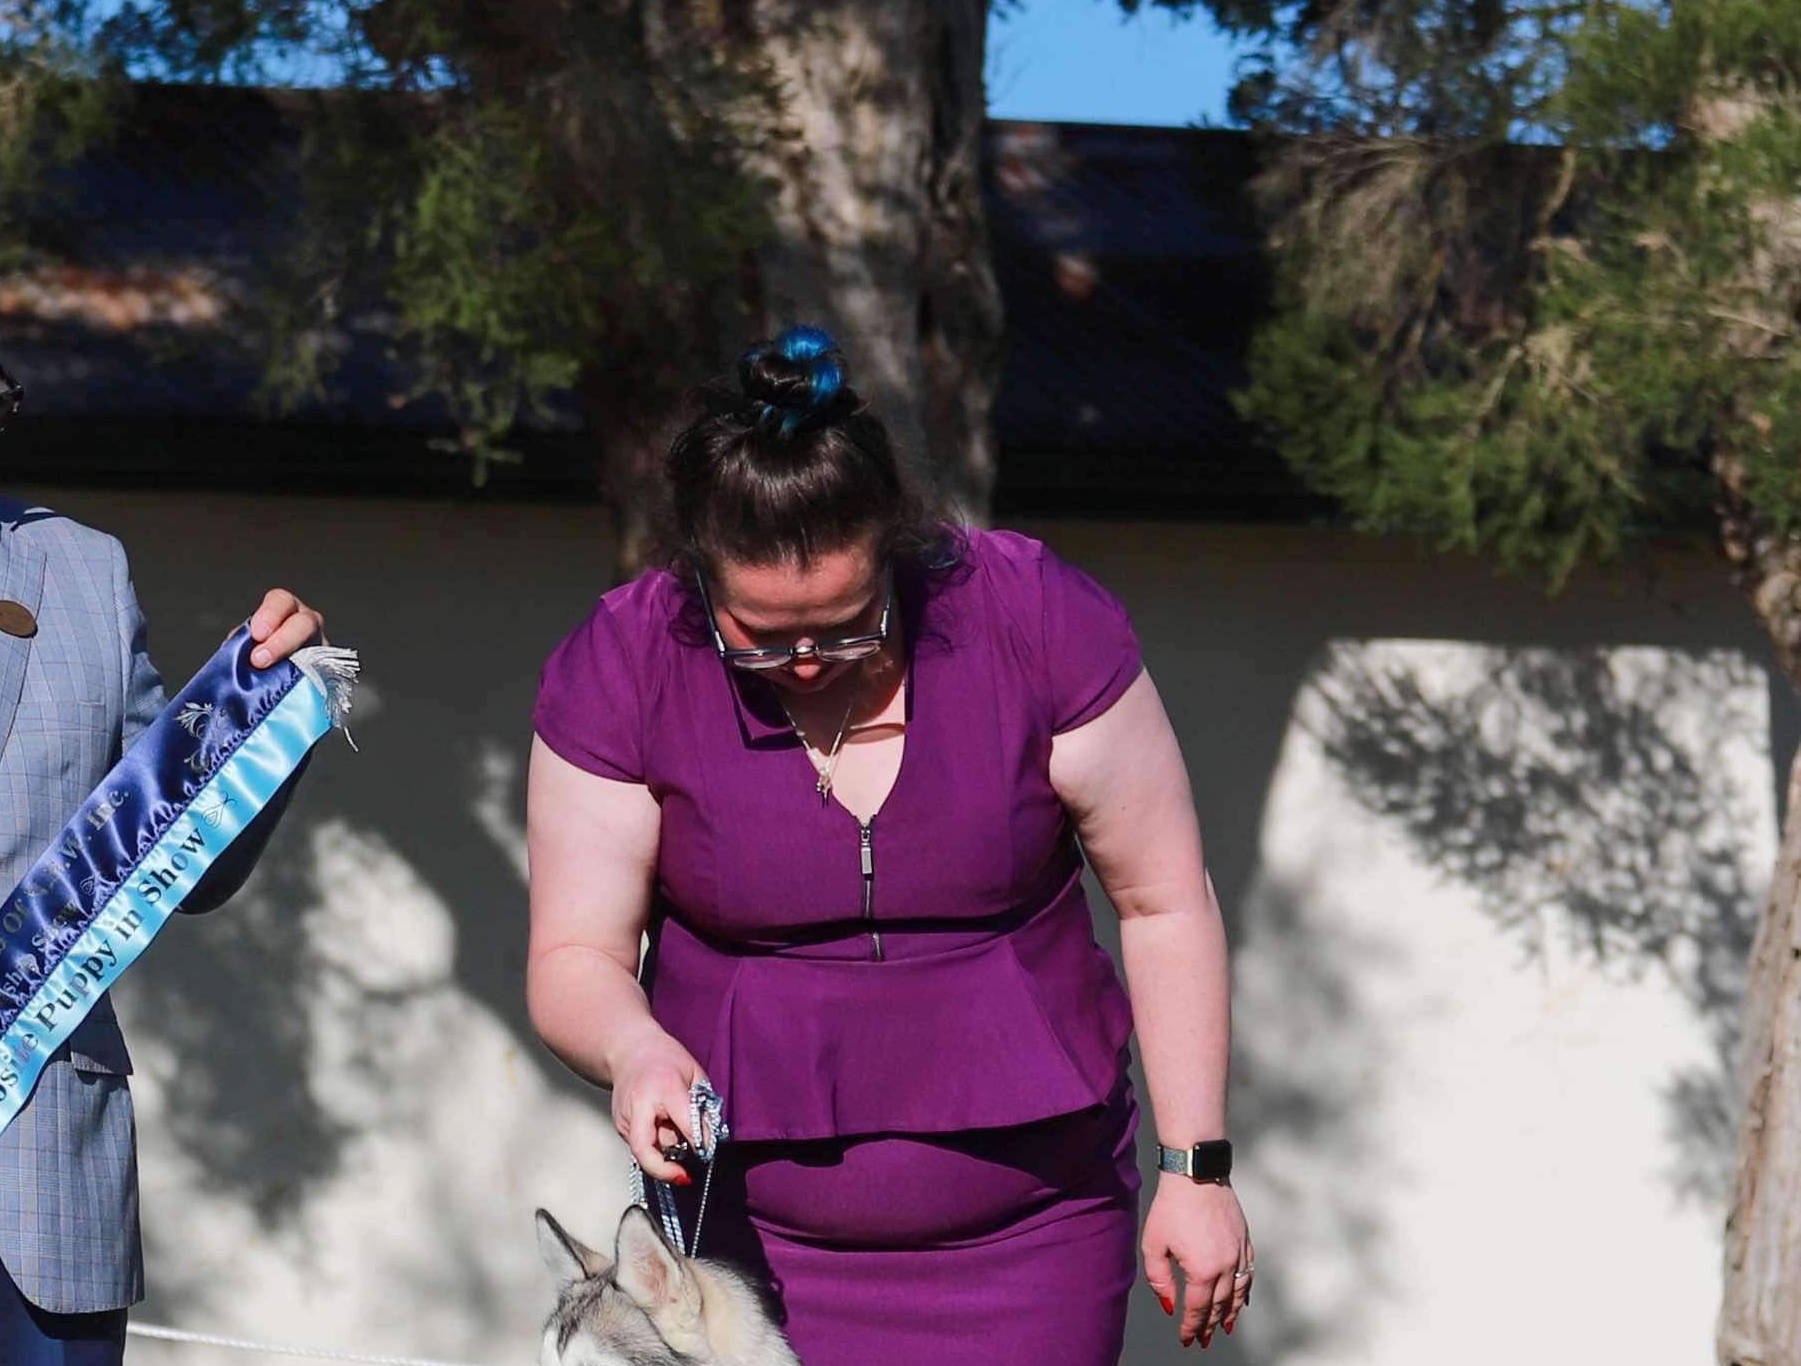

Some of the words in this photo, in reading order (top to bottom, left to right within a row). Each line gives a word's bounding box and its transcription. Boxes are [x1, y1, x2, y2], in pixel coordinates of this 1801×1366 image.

[2, 897, 31, 934] Of
[86, 790, 130, 833] Inc.
[36, 938, 120, 1032] Puppy
[113, 907, 143, 941] in
[137, 825, 207, 906] Show
